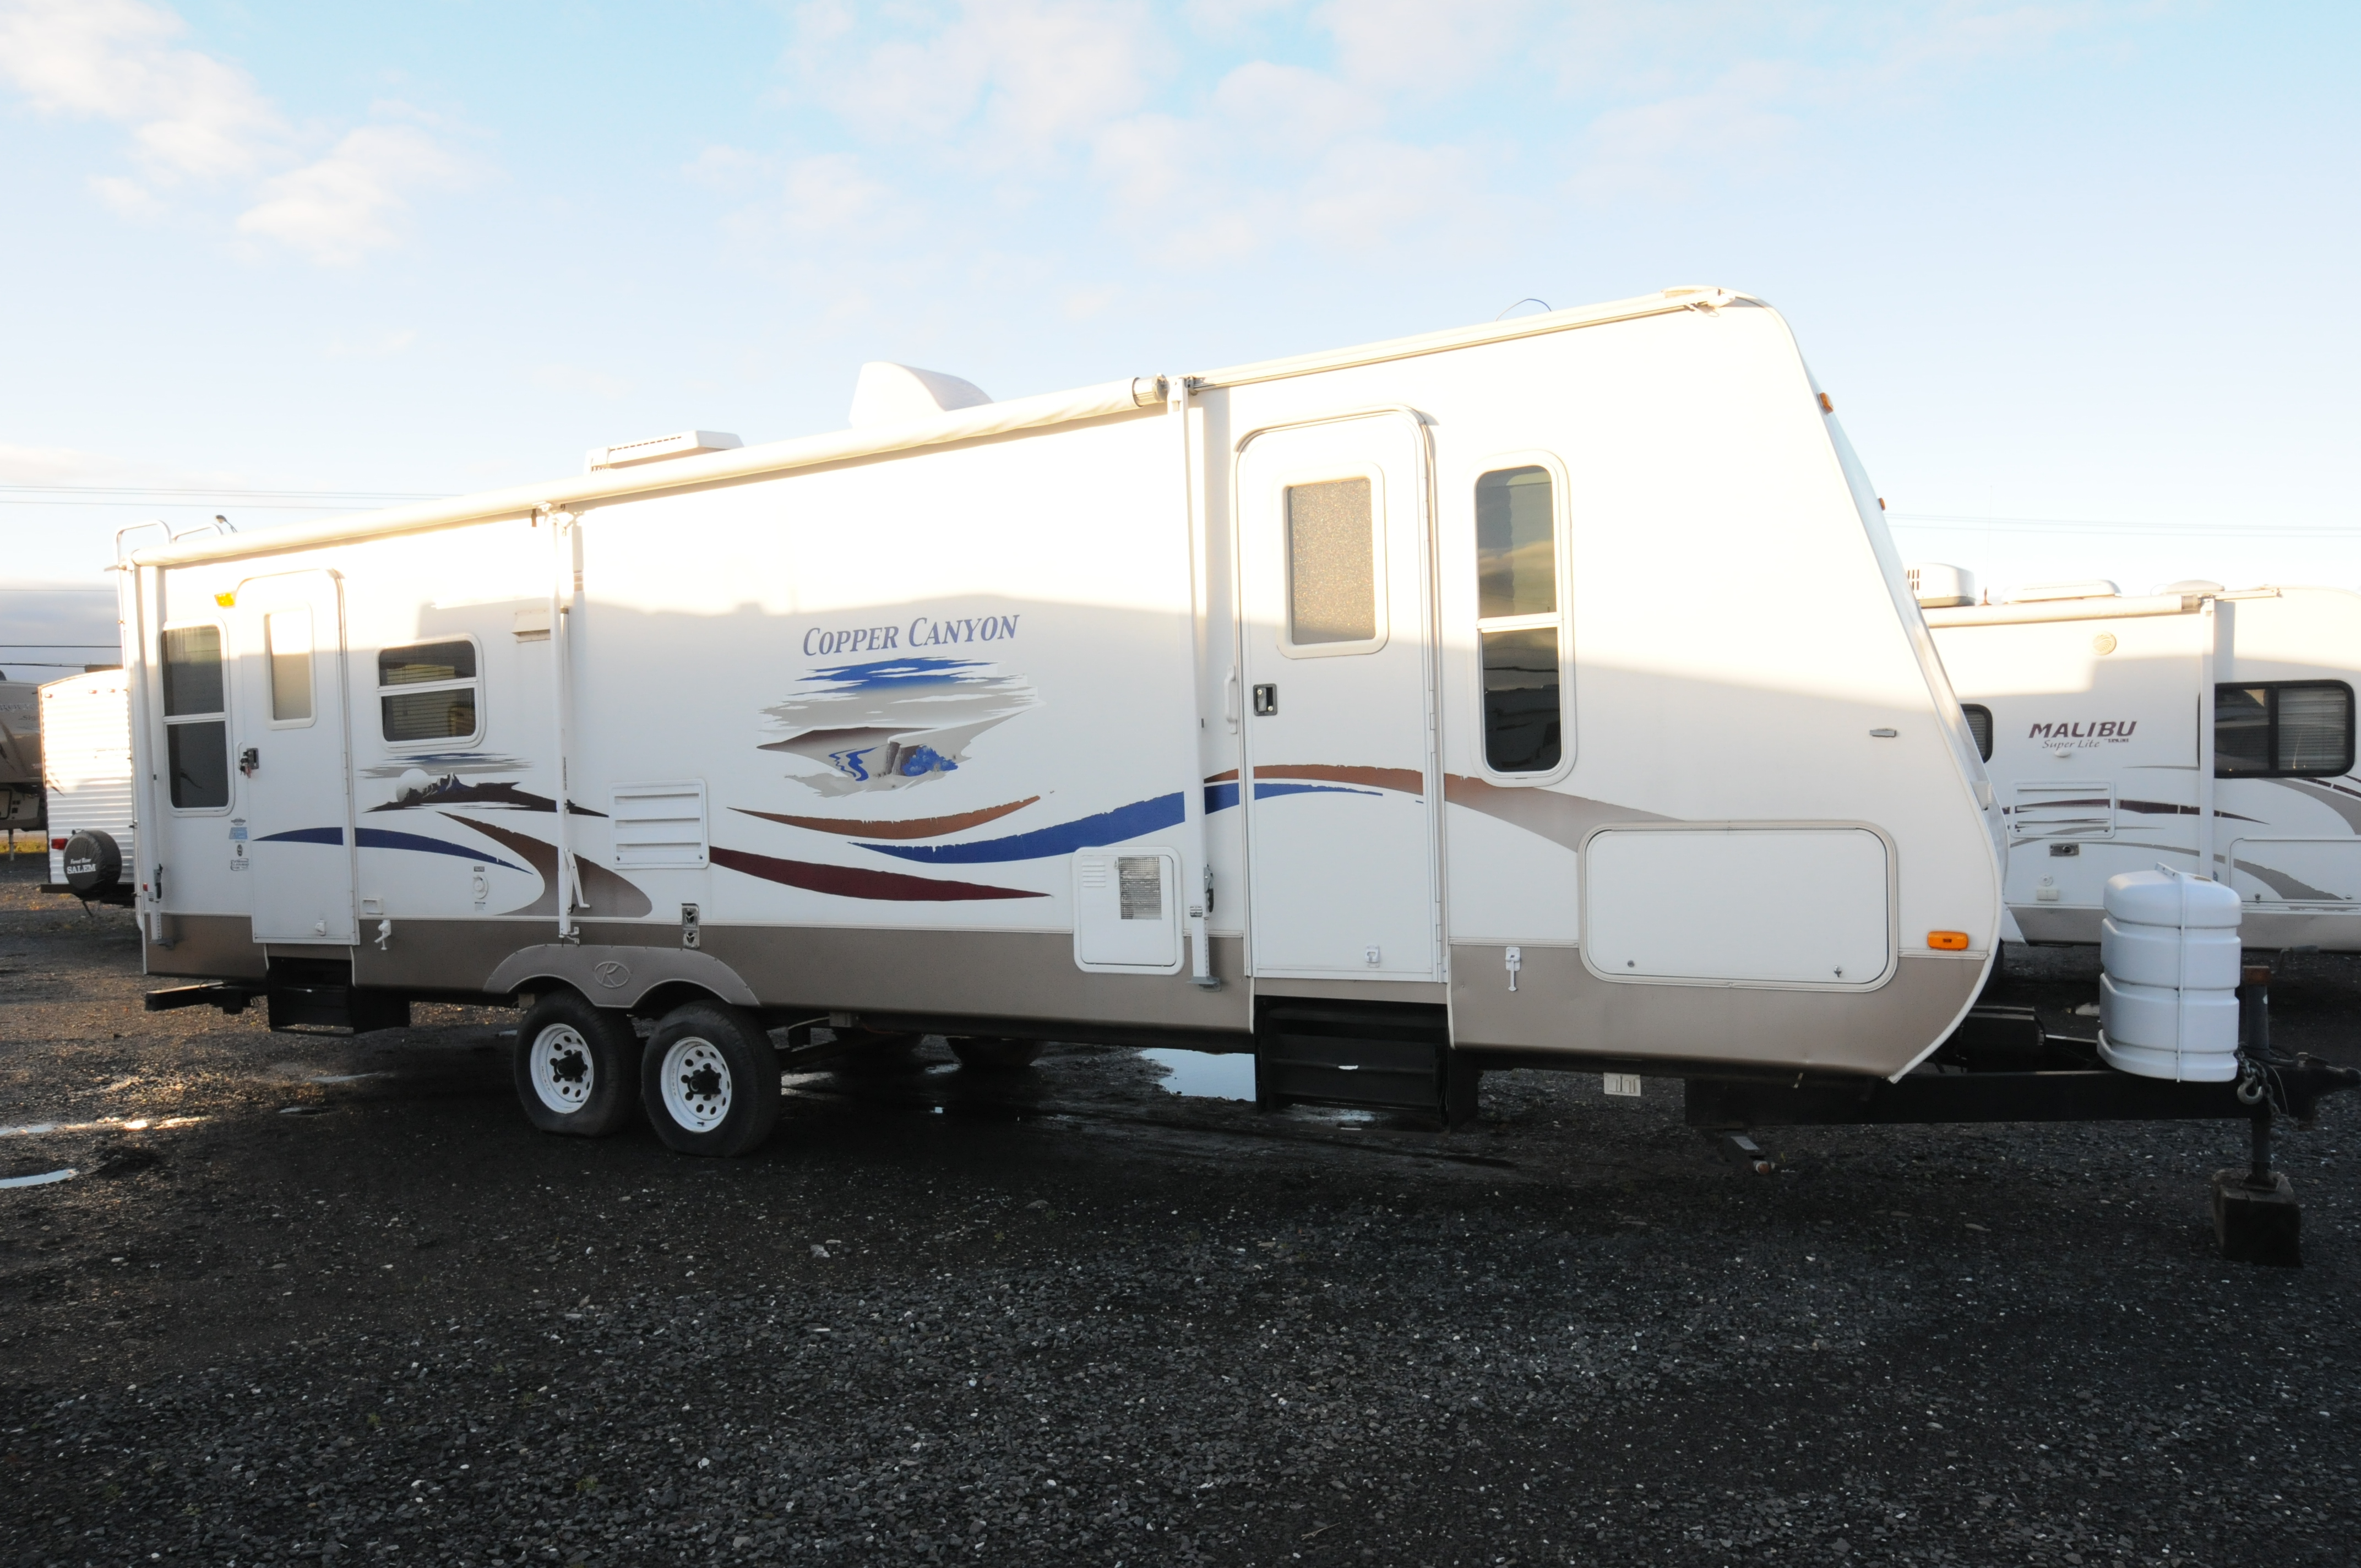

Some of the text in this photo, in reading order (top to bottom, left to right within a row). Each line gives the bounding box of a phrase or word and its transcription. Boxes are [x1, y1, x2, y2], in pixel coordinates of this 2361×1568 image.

[803, 614, 1020, 656] COPPER CANYON
[2028, 721, 2137, 738] MALIBU
[2042, 739, 2100, 750] Super Lite
[67, 864, 96, 874] SALEM
